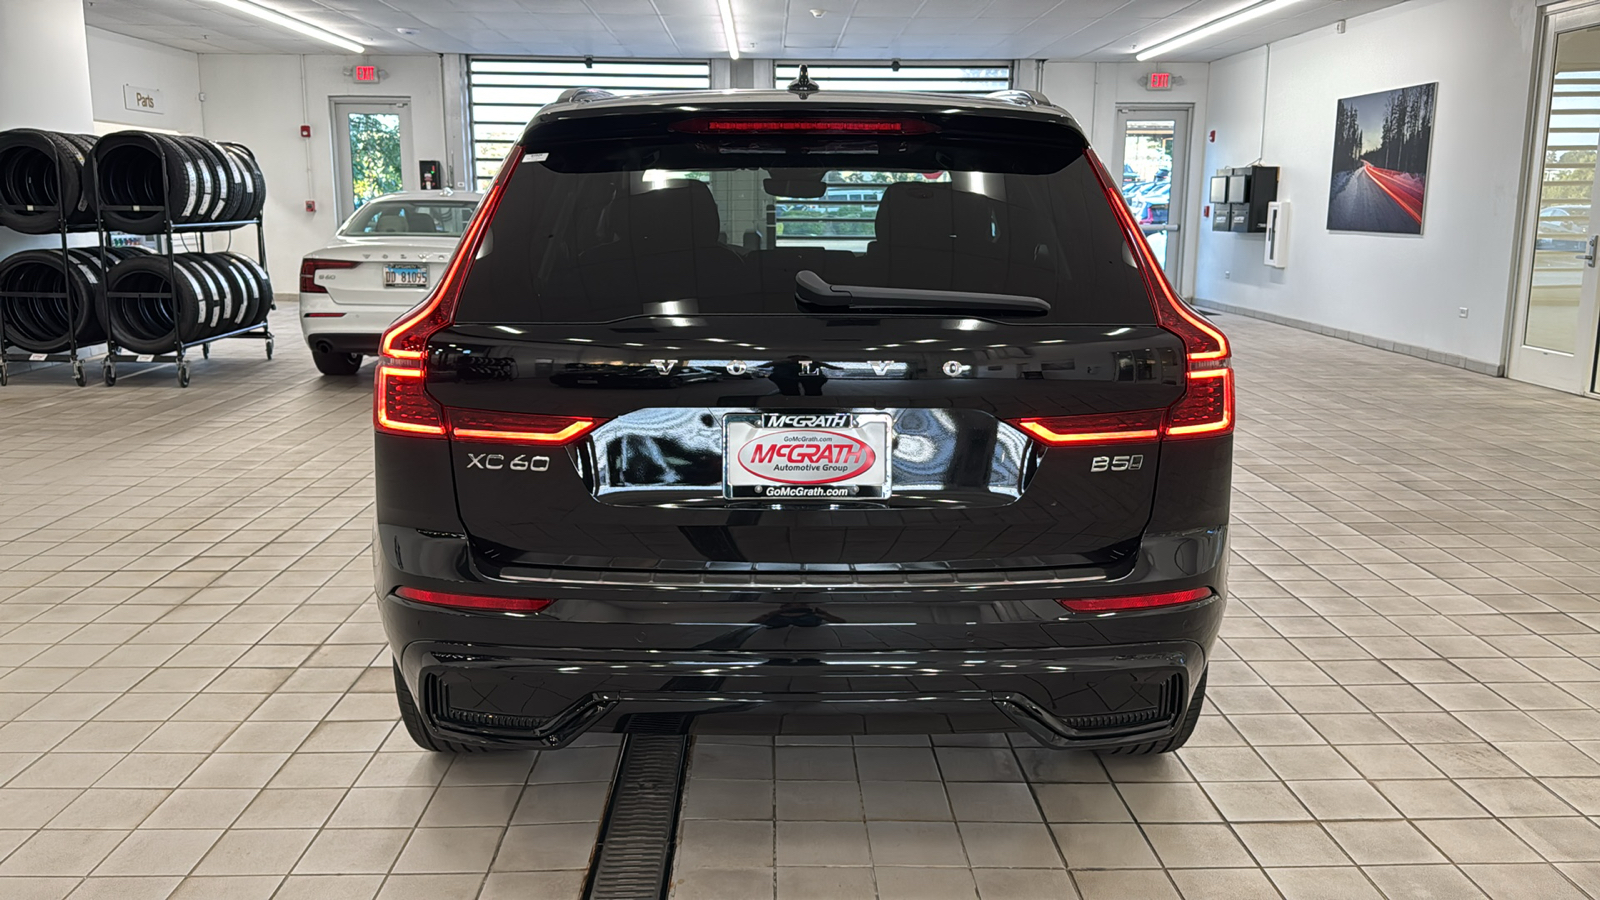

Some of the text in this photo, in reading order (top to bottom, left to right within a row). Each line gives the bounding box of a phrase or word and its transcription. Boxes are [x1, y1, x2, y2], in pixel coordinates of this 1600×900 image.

[356, 66, 375, 81] EXIT
[1151, 73, 1170, 88] EXIT
[401, 271, 428, 284] 81095
[650, 359, 963, 376] VOLVO
[784, 435, 833, 443] GoMcGrath.com
[773, 464, 848, 472] Automotive Group
[766, 487, 849, 497] GoMcGrath.com
